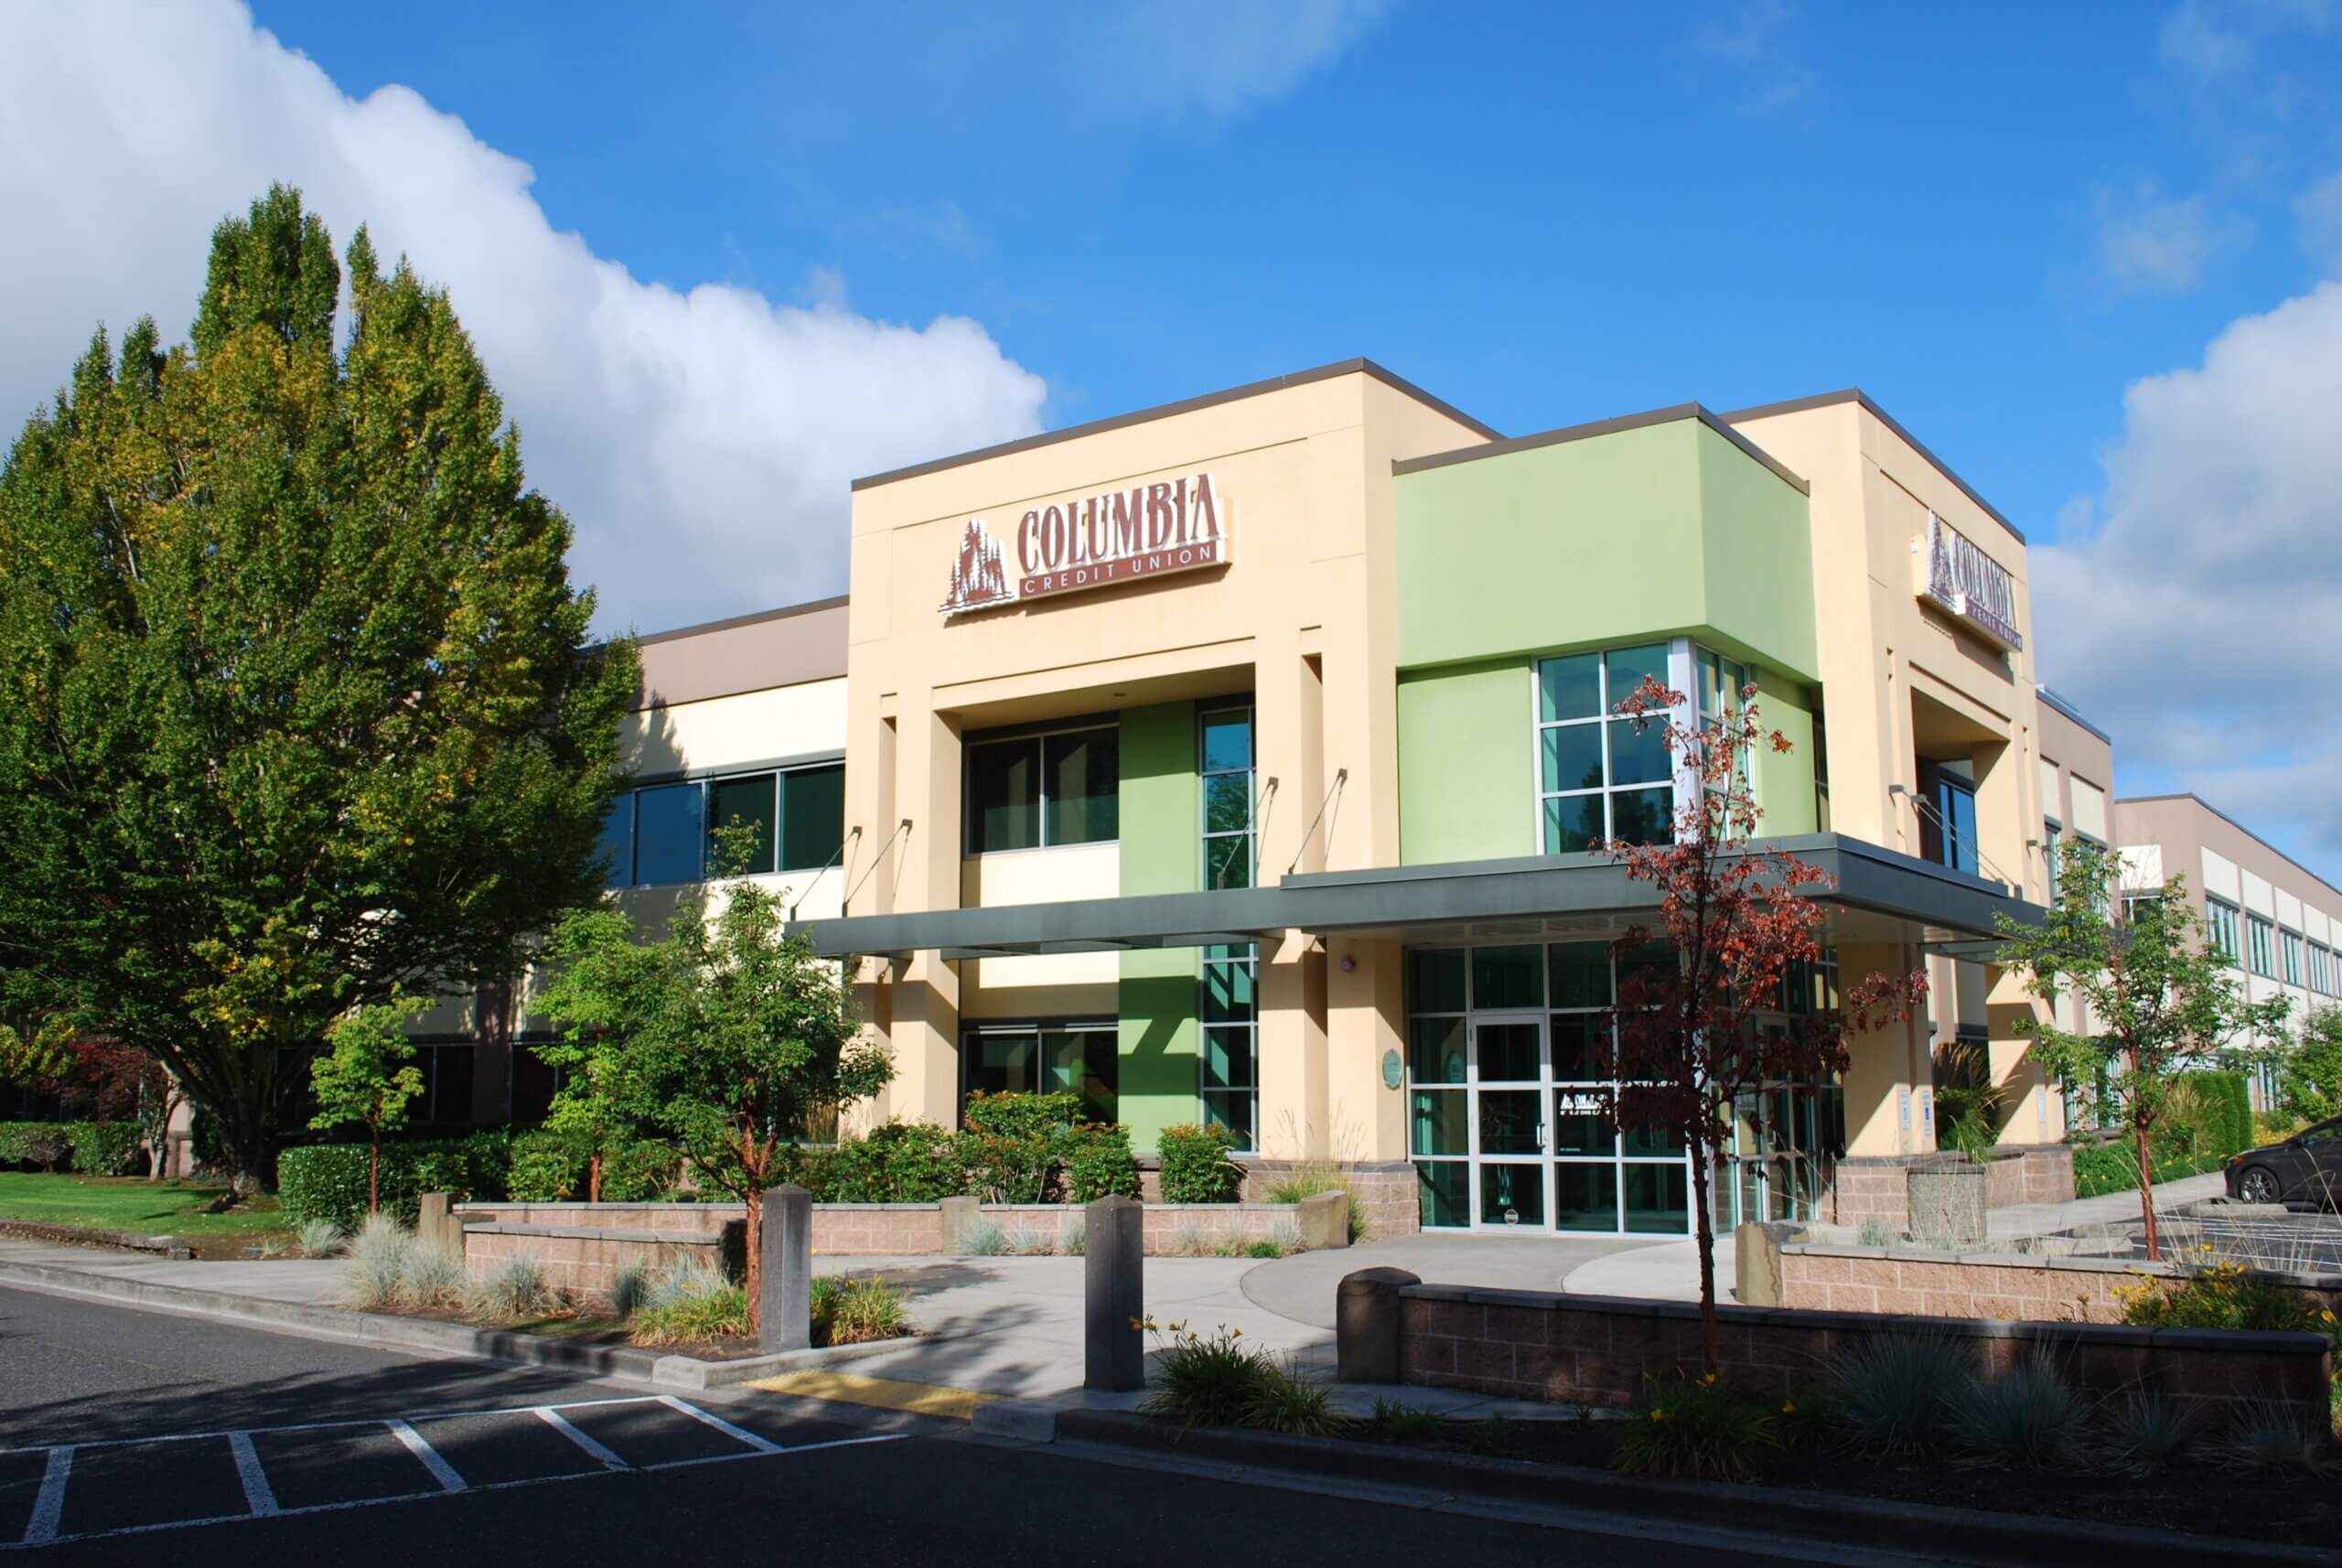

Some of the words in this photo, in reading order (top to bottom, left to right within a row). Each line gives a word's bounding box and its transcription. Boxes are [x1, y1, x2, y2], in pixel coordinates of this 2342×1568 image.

[1017, 473, 1219, 575] COLUMBIA
[1025, 564, 1114, 593] CREDIT
[1133, 545, 1211, 573] UNION
